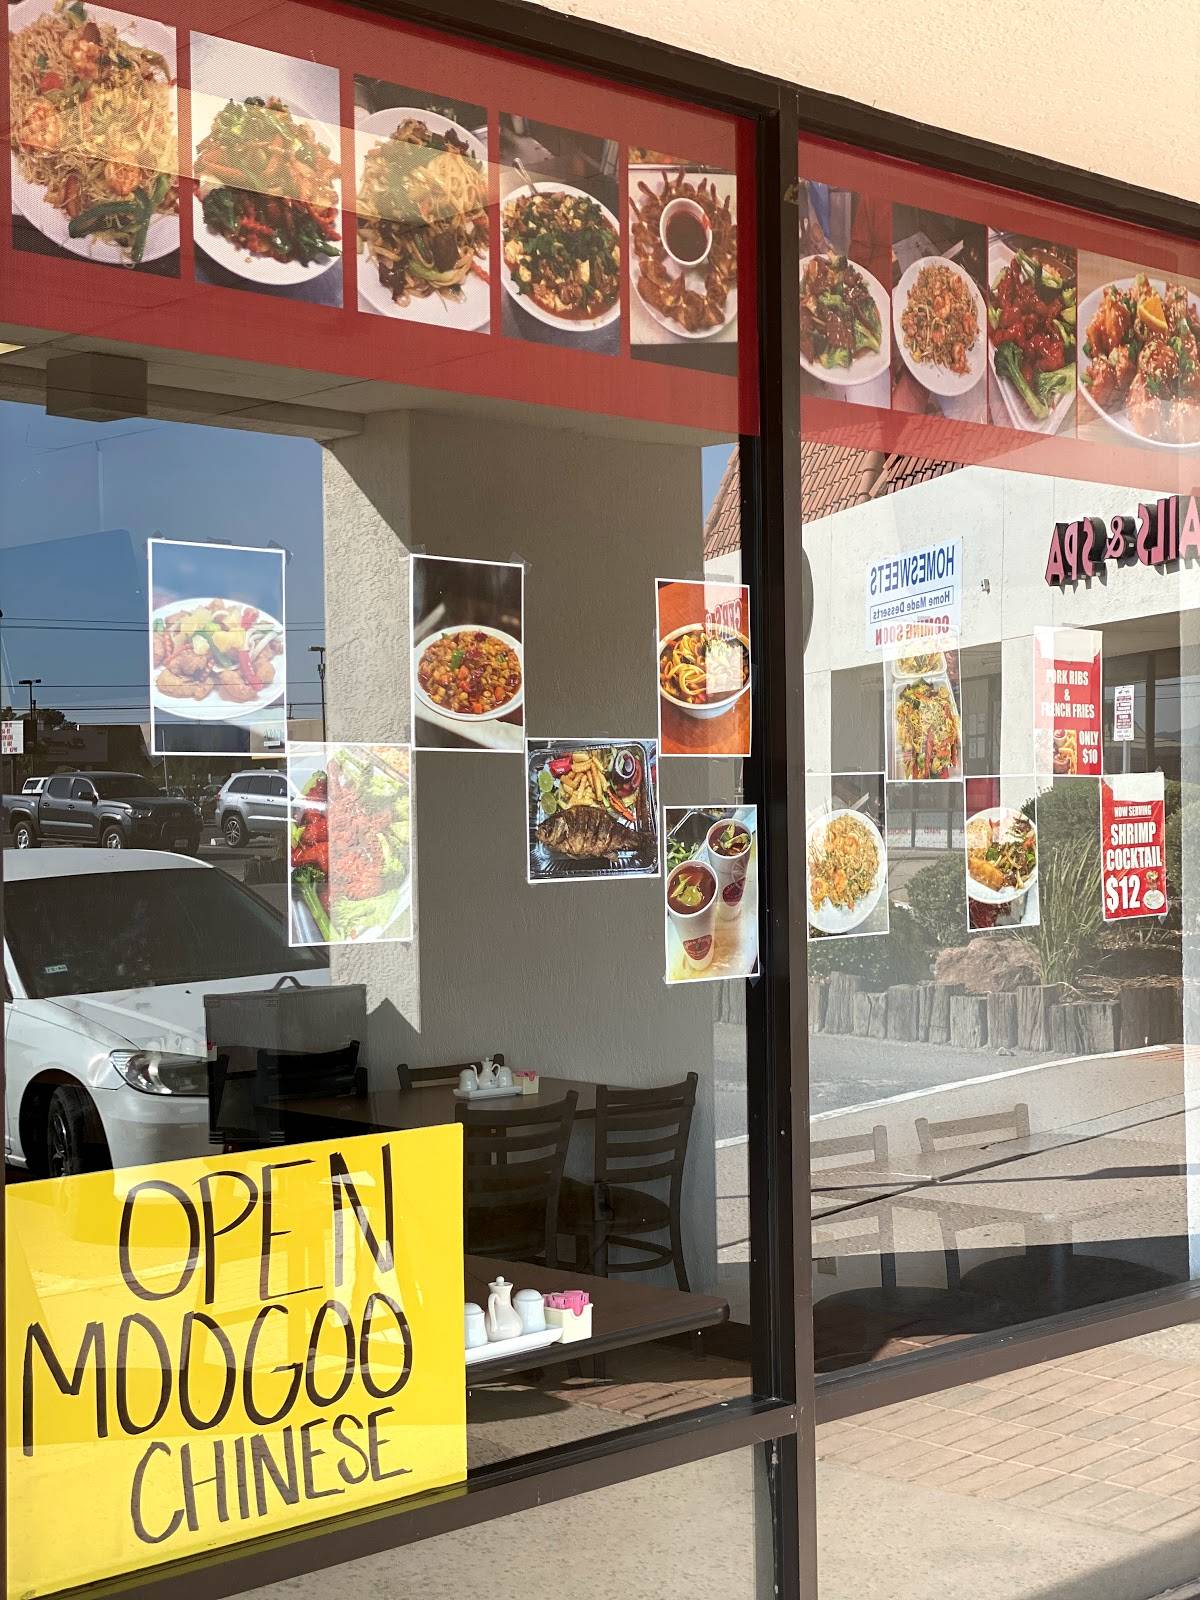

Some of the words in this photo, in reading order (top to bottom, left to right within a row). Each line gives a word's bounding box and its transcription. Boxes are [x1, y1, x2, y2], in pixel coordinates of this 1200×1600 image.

[1069, 670, 1089, 686] RIBS
[1064, 689, 1071, 702] &
[1072, 703, 1095, 718] FRIES
[1079, 730, 1099, 746] ONLY
[1082, 748, 1098, 765] $10
[1114, 806, 1128, 818] NOW
[1128, 805, 1152, 817] SERVING
[1110, 822, 1156, 846] SHRIMP
[1106, 845, 1162, 871] COCKTAIL
[1105, 874, 1141, 913] $12
[118, 1143, 396, 1304] OPEN
[22, 1292, 413, 1457] MOOGOO
[130, 1406, 413, 1544] CHINESE
